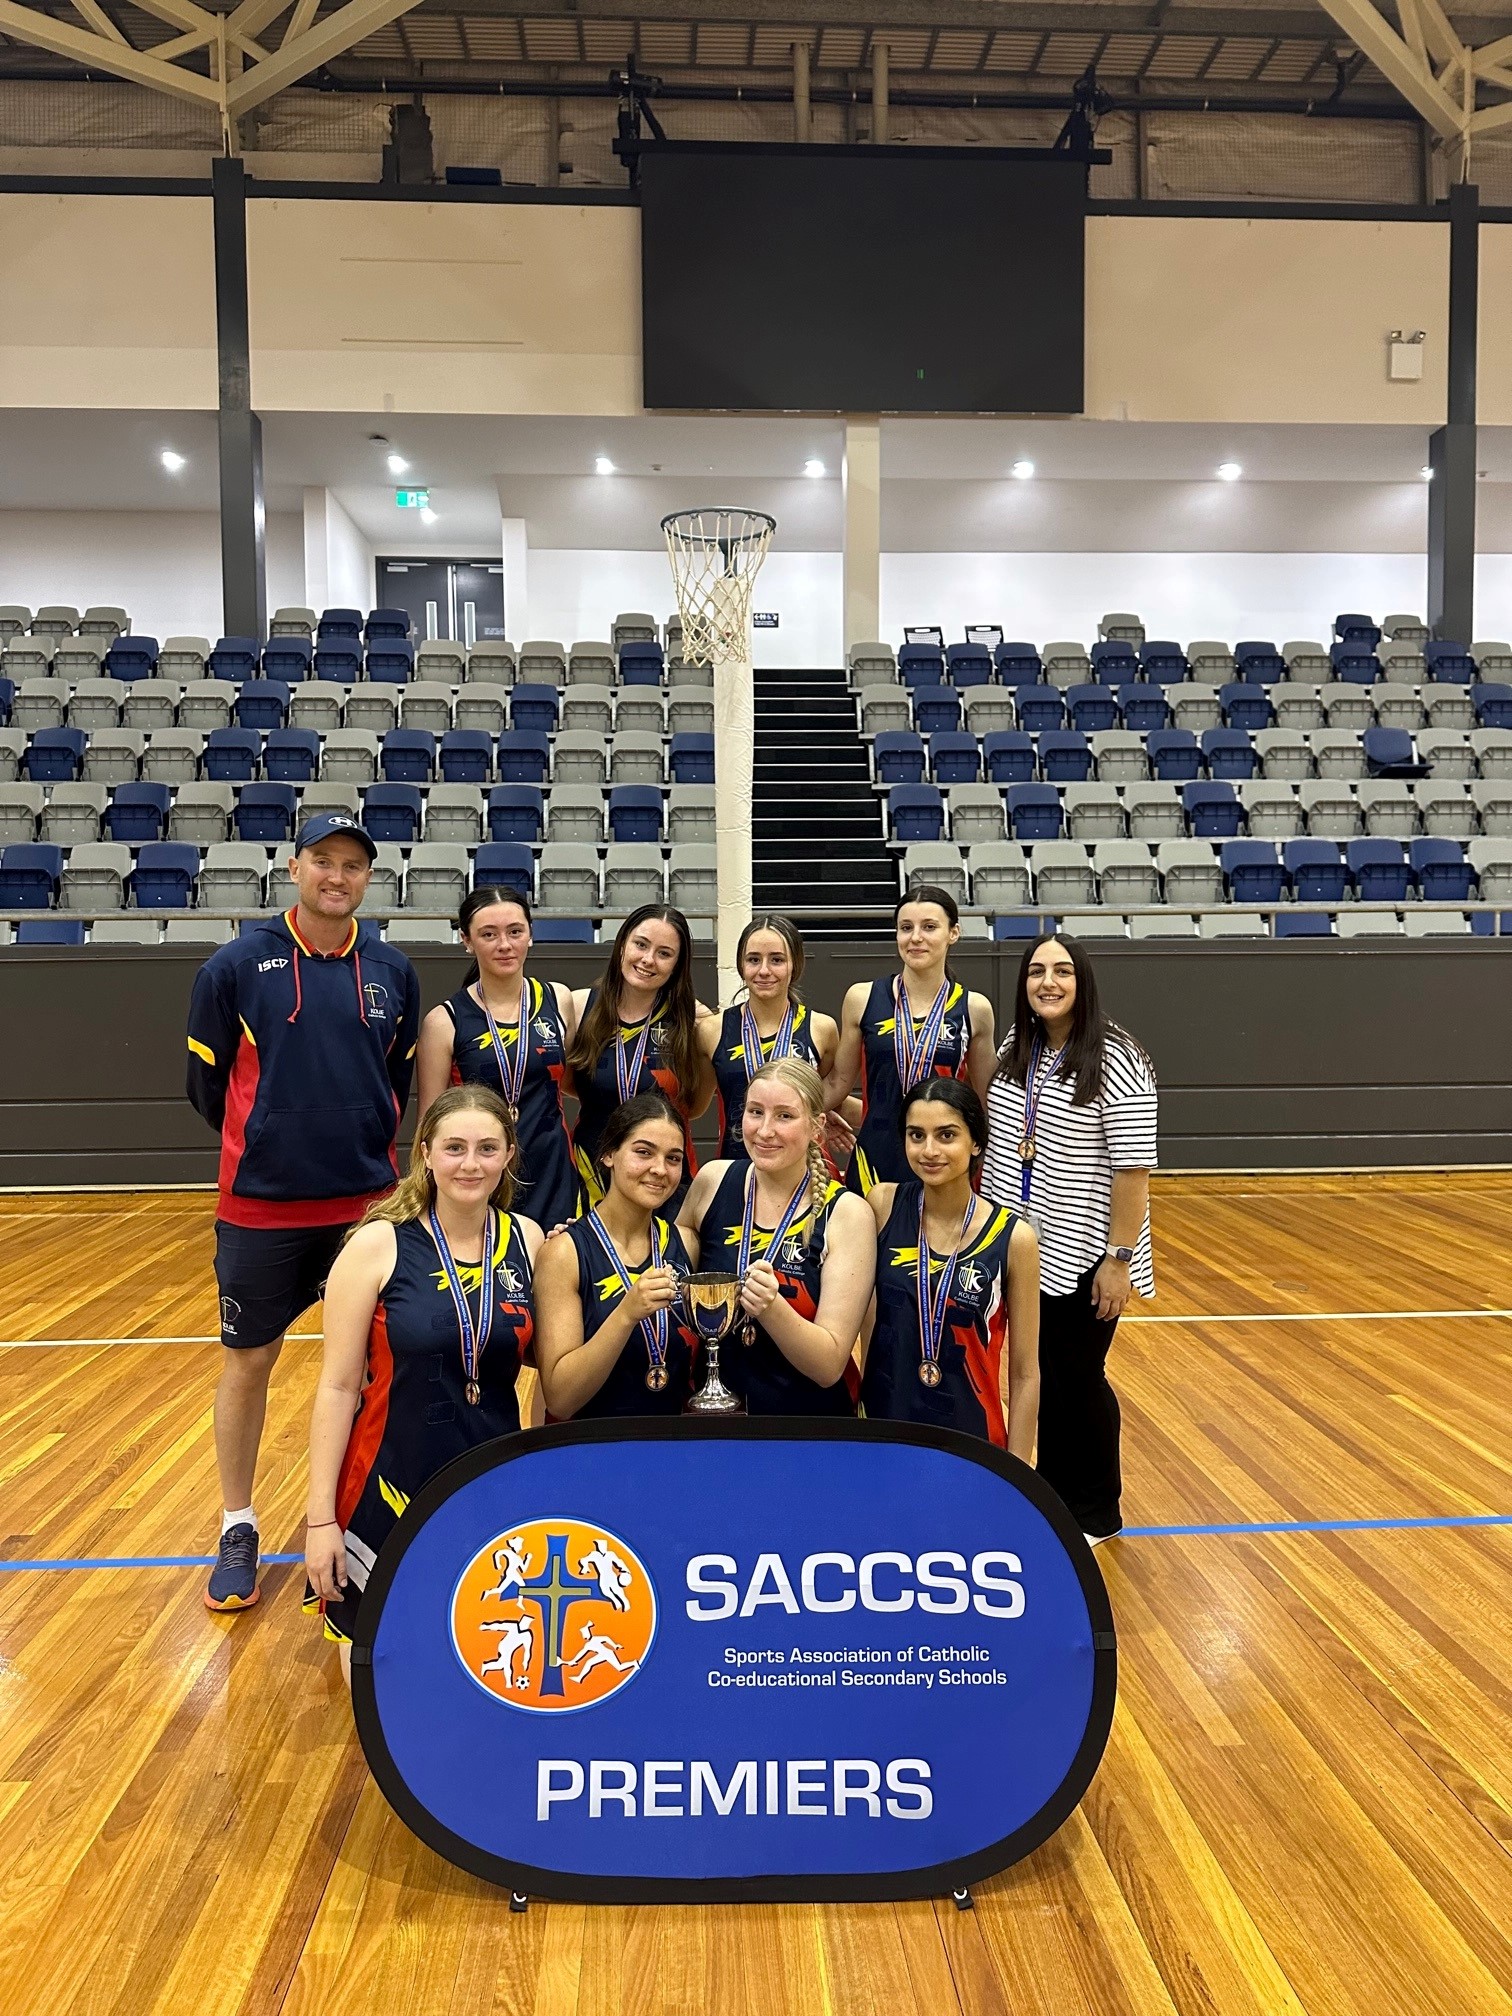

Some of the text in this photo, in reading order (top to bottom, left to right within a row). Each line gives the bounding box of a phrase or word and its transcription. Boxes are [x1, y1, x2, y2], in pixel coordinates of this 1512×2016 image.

[781, 1263, 803, 1271] KOLBE
[958, 1290, 980, 1302] KOLBE
[685, 1551, 1026, 1622] SACCSS
[724, 1646, 990, 1667] Sports Association of Catholic
[707, 1669, 1007, 1689] Co-educational Secondary Schools
[536, 1758, 934, 1822] PREMIERS
